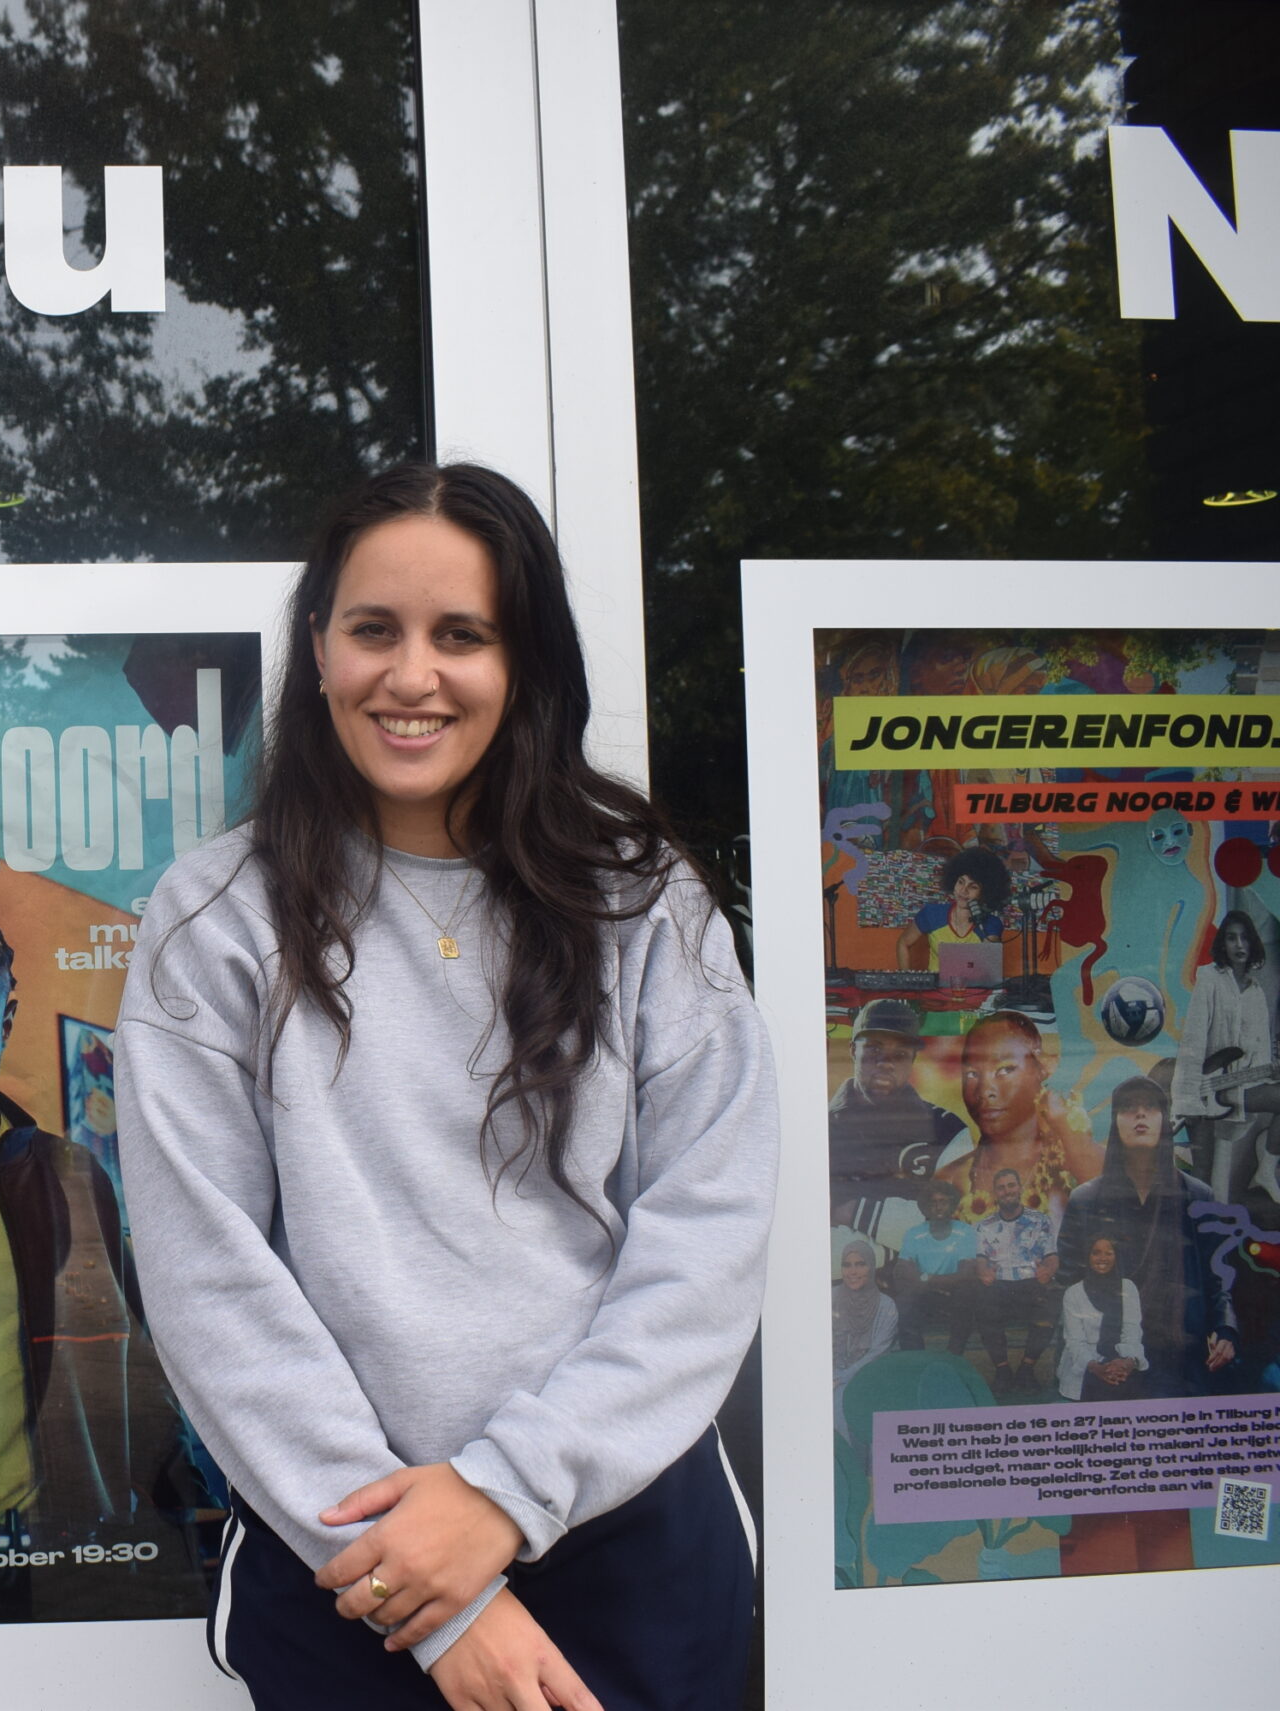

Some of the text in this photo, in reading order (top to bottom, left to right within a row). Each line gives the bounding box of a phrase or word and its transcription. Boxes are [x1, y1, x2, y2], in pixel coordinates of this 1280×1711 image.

[850, 714, 1280, 751] JONGERENFOND
[966, 791, 1099, 815] TILBURG
[1105, 790, 1215, 814] NOORD
[1224, 789, 1242, 813] &
[897, 1424, 930, 1435] Ben
[932, 1422, 945, 1435] jij
[949, 1421, 1002, 1432] tussen
[1006, 1420, 1027, 1430] de
[1030, 1418, 1047, 1429] 16
[1050, 1418, 1070, 1428] en
[1073, 1416, 1096, 1427] 27
[1135, 1413, 1179, 1424] woon
[1181, 1411, 1196, 1423] je
[1199, 1410, 1212, 1420] in
[1215, 1408, 1272, 1420] Tilburg
[902, 1437, 944, 1448] West
[947, 1438, 967, 1447] en
[970, 1434, 1001, 1445] heb
[1004, 1433, 1019, 1446] je
[1022, 1434, 1051, 1443] een
[1055, 1429, 1098, 1441] idee?
[1101, 1428, 1130, 1439] Het
[1132, 1421, 1248, 1440] jongerenfonds
[890, 1452, 929, 1463] kans
[931, 1452, 958, 1461] om
[961, 1449, 982, 1460] dit
[984, 1448, 1019, 1459] idee
[1022, 1441, 1127, 1457] werkelijkheid
[1130, 1441, 1146, 1451] te
[1207, 1437, 1228, 1448] Je
[1230, 1434, 1272, 1447] krijgt
[909, 1467, 940, 1476] een
[943, 1462, 1004, 1475] budget,
[1007, 1461, 1051, 1471] maar
[1054, 1458, 1084, 1469] ook
[1086, 1456, 1152, 1468] toegang
[1155, 1453, 1177, 1464] tot
[1179, 1450, 1244, 1463] ruimtes,
[893, 1476, 1007, 1493] professionele
[1010, 1471, 1107, 1487] begeleiding.
[1109, 1470, 1136, 1481] Zet
[1139, 1469, 1159, 1479] de
[1161, 1466, 1214, 1477] eerste
[1216, 1464, 1250, 1476] stap
[1253, 1464, 1273, 1473] en
[1037, 1480, 1213, 1501] jongerenfonds aan via
[71, 1541, 159, 1566] 19:30
